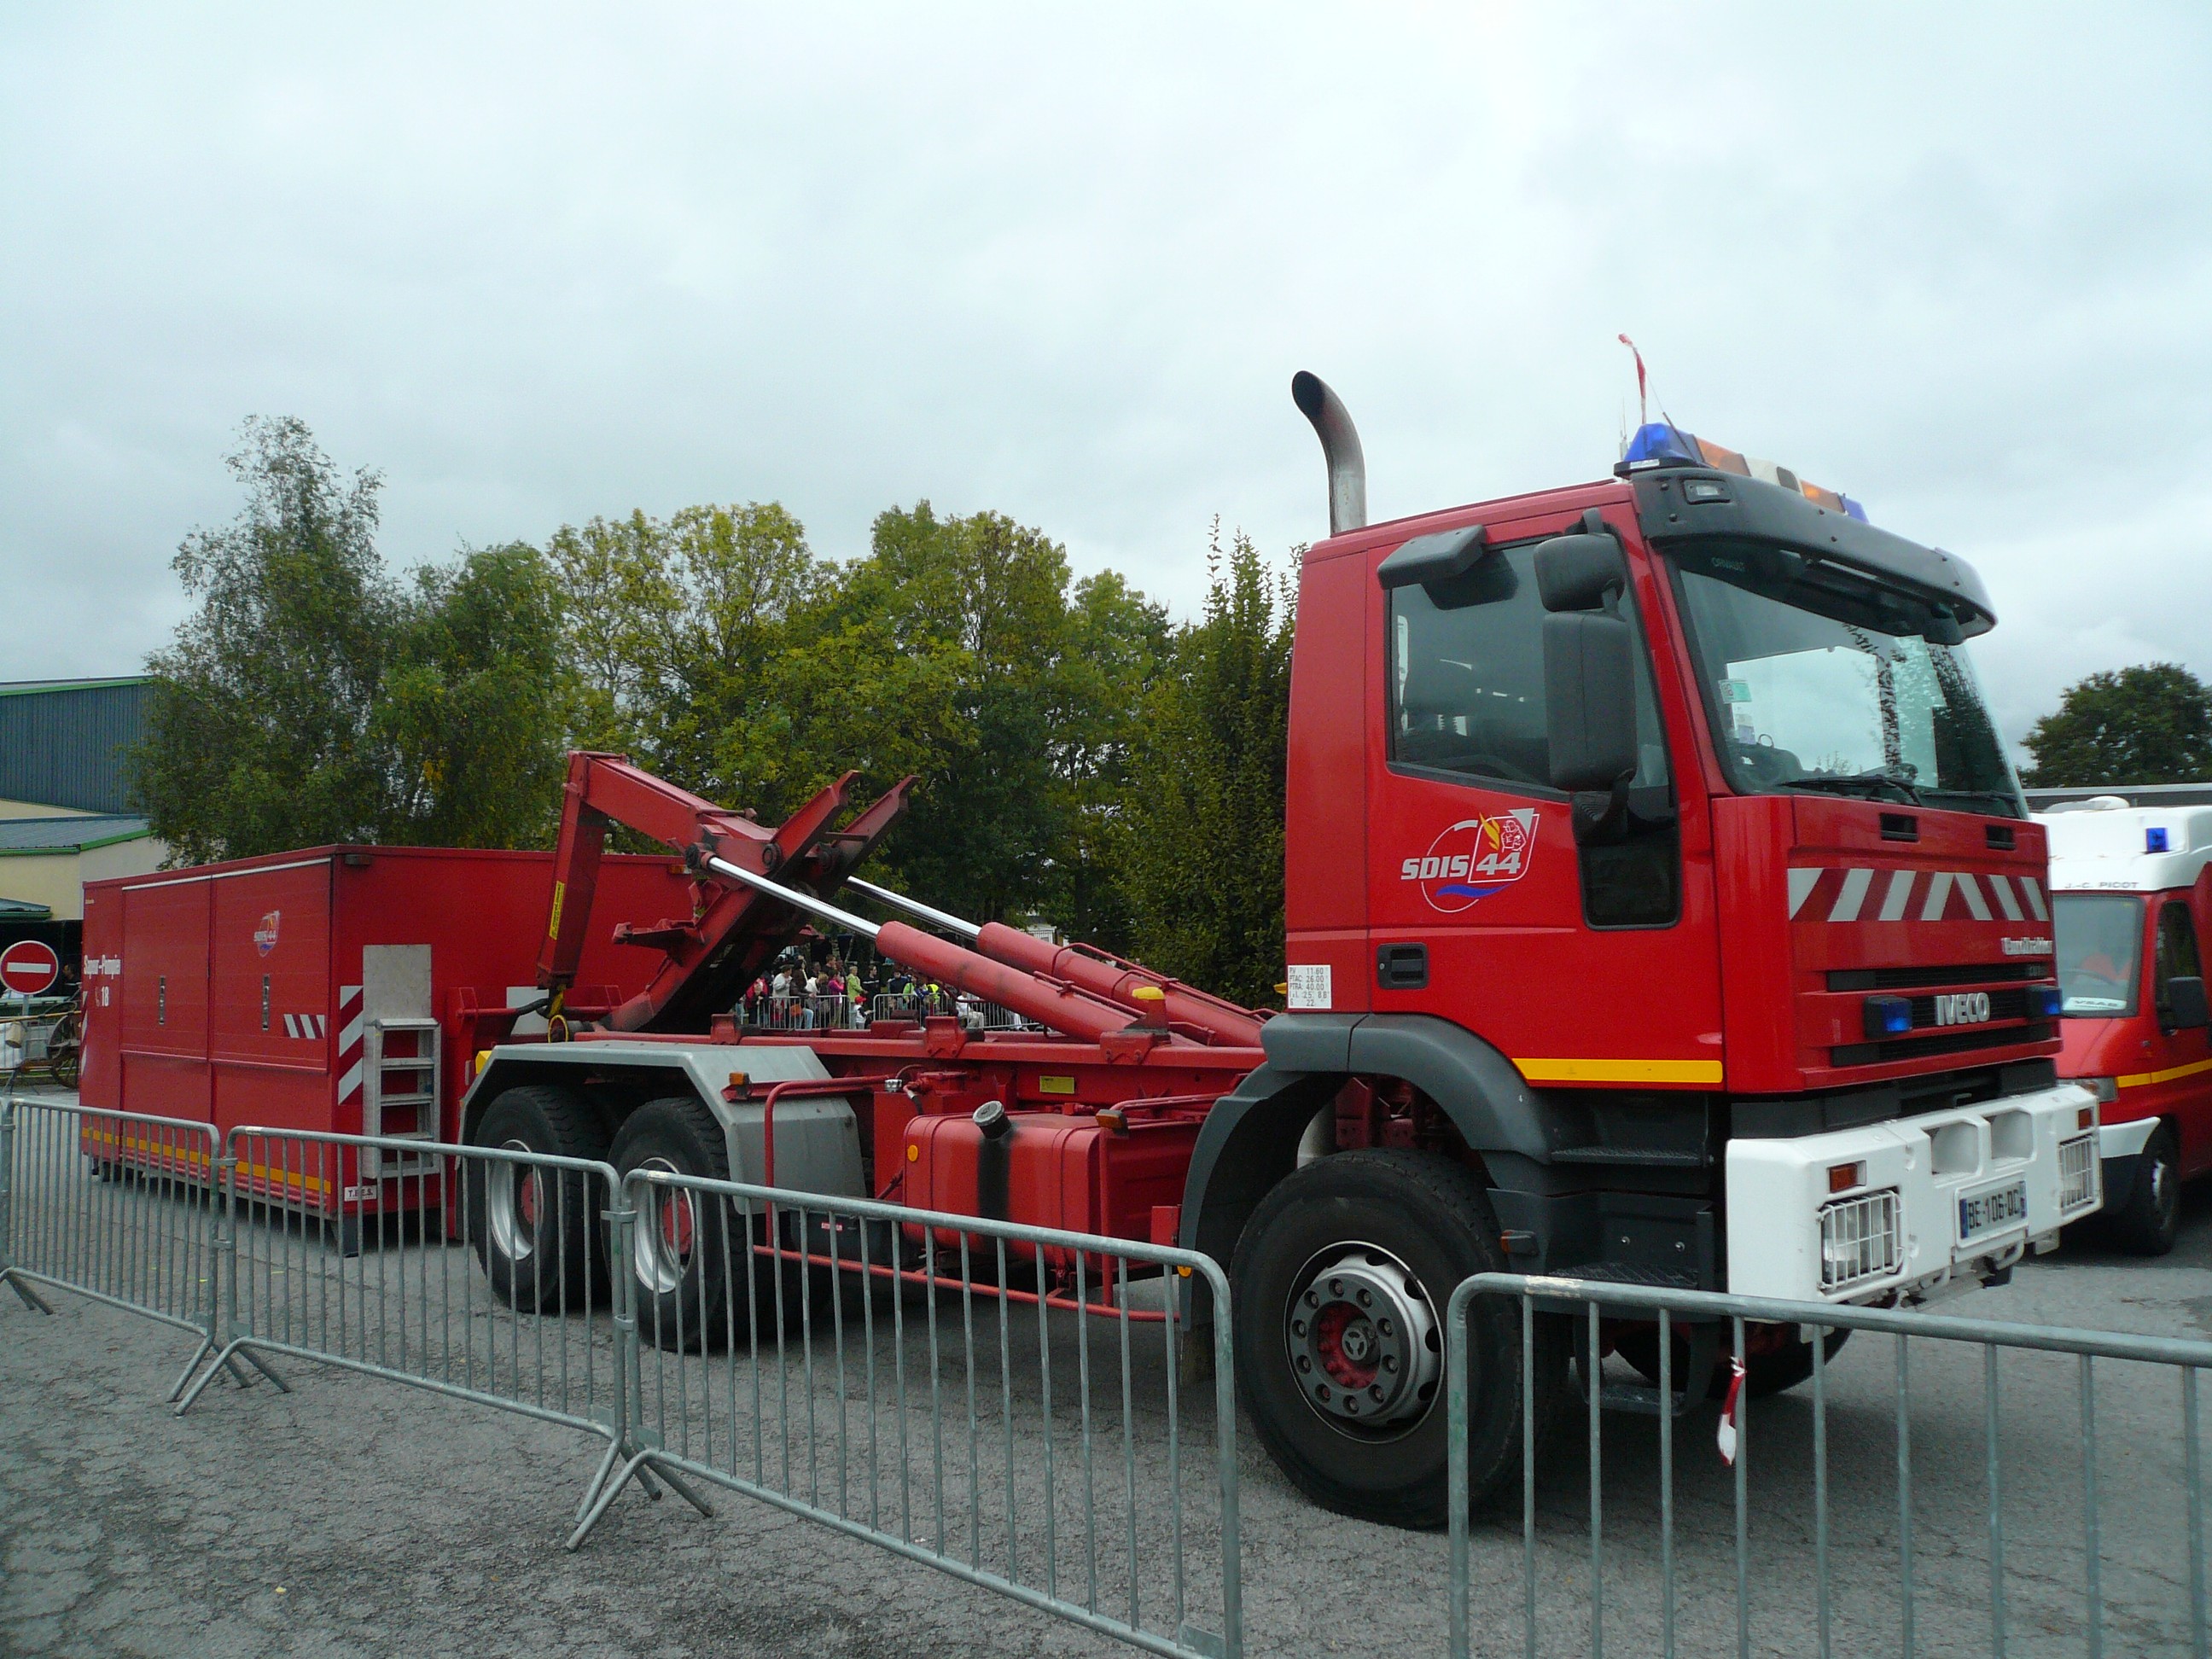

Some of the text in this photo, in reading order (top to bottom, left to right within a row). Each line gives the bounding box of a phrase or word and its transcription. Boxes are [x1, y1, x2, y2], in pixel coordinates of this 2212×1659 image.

[1400, 852, 1522, 880] SDIS 44
[102, 986, 109, 1006] 18
[1936, 992, 1990, 1026] IVECO
